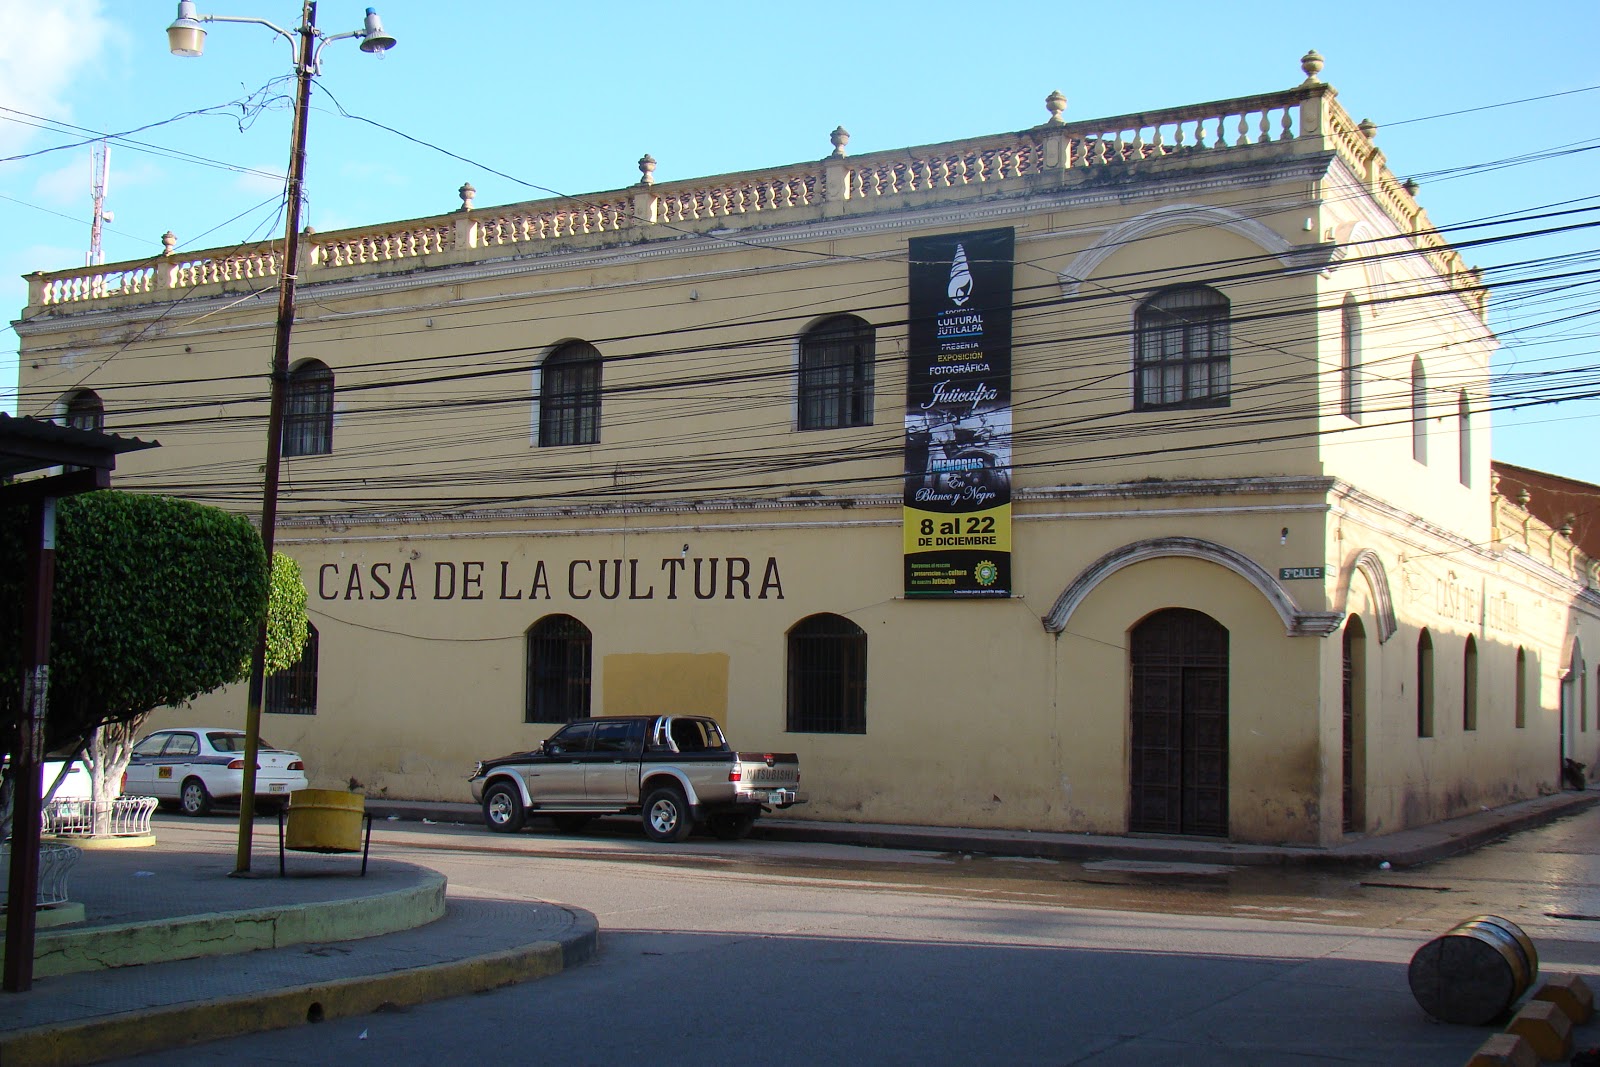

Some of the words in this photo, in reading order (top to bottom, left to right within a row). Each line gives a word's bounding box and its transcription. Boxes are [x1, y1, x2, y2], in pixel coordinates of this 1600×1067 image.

[937, 314, 983, 326] CULTURAL
[937, 324, 983, 335] JUTICALPA
[941, 342, 979, 350] PRESENTA
[937, 351, 983, 362] EXPOSICIÓN
[929, 363, 990, 375] FOTOGRÁFICA
[920, 380, 997, 409] Juticalpa
[932, 458, 984, 472] MEMORIAS
[947, 474, 965, 489] En
[915, 488, 952, 501] Blanco
[951, 494, 961, 506] y
[962, 486, 996, 505] Negro
[920, 519, 934, 535] 8
[940, 518, 960, 535] al
[966, 516, 996, 534] 22
[918, 538, 932, 546] DE
[936, 536, 997, 546] DICIEMBRE
[318, 562, 418, 601] CASA
[434, 561, 484, 600] DE
[500, 560, 551, 600] LA
[568, 557, 785, 600] CULTURA
[1293, 568, 1320, 578] CALLE
[746, 769, 794, 780] MITSUBISHI
